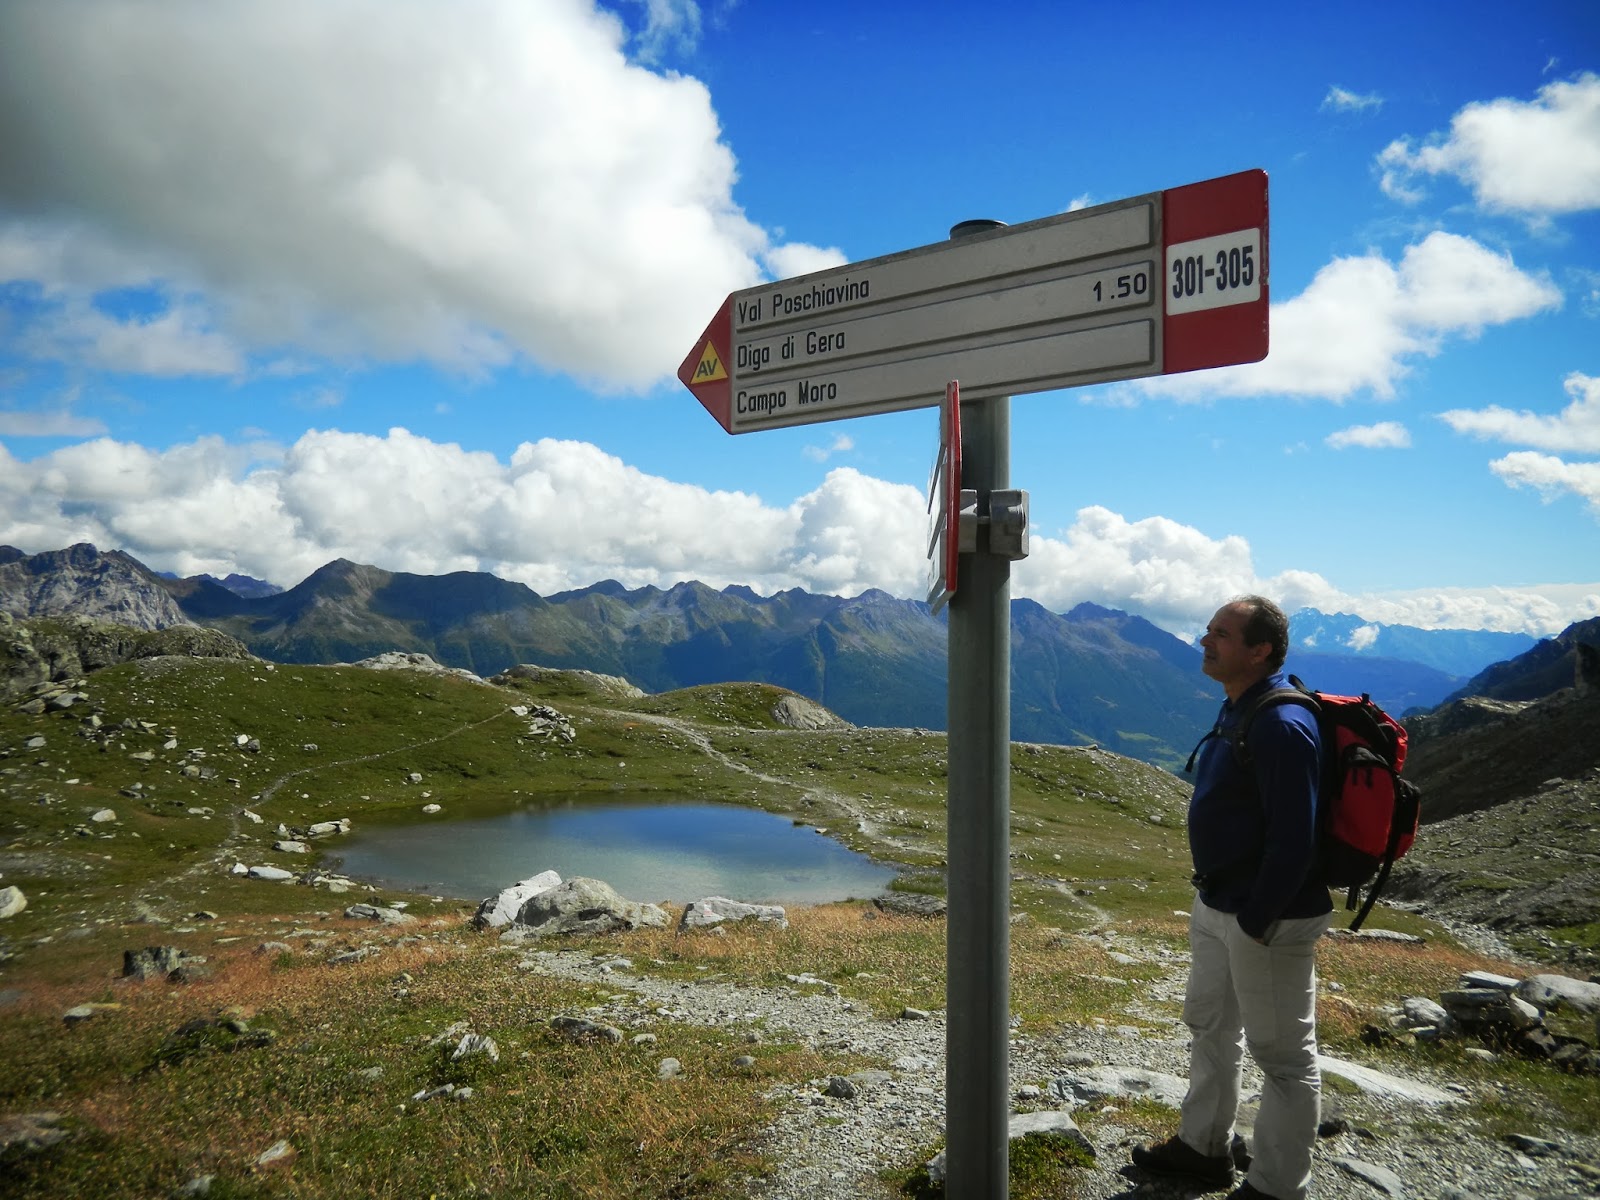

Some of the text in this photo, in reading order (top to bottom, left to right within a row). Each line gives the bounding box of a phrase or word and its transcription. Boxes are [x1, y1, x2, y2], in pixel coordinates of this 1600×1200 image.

[1093, 273, 1147, 302] 1.50
[1172, 245, 1254, 299] 301-305
[738, 278, 870, 324] Val Poschiavina
[696, 358, 718, 378] AV
[737, 331, 845, 371] Diga di Gera
[737, 380, 837, 415] Campo Moro
